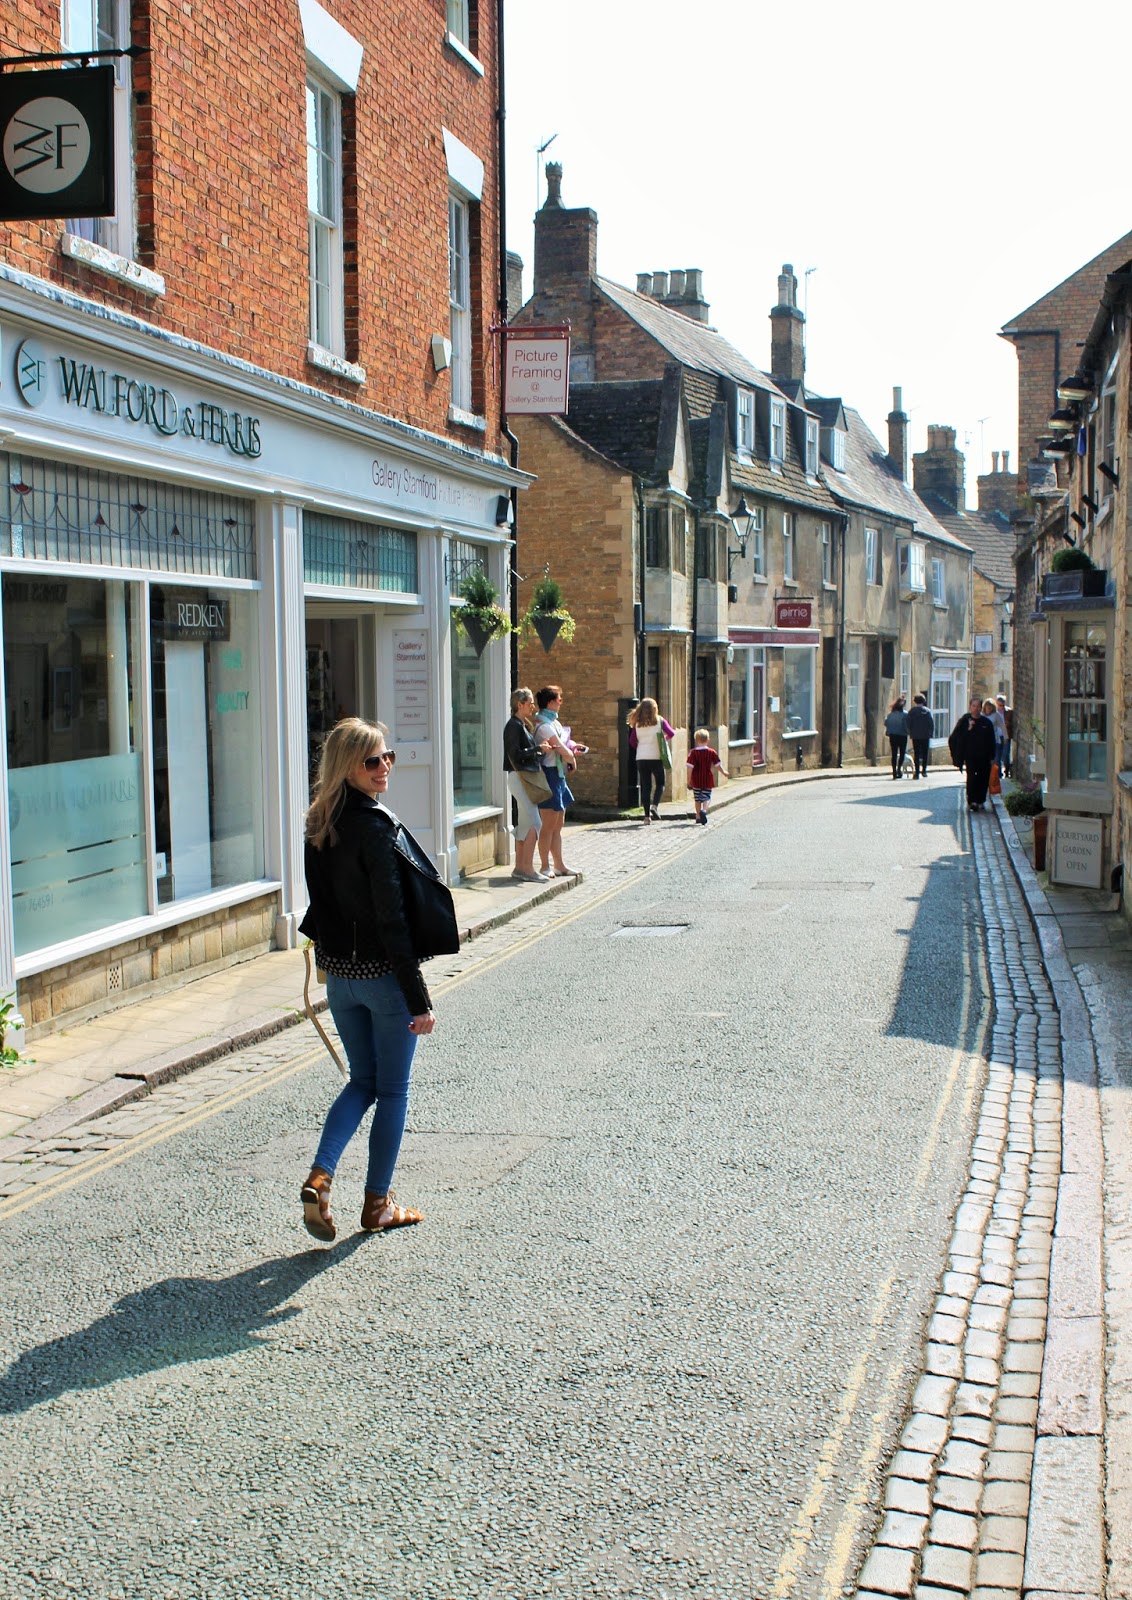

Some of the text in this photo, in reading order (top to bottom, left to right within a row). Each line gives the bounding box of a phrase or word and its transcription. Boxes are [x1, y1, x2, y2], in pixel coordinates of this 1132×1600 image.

[515, 350, 558, 361] Picture
[511, 366, 562, 381] Framing
[530, 382, 540, 392] @
[533, 395, 564, 403] Stamford
[59, 356, 262, 458] WALFORD & FERRIS
[371, 460, 401, 496] Gallery
[403, 468, 437, 500] Stamford
[177, 603, 225, 628] REDKEN
[398, 642, 422, 650] Gallery
[396, 653, 426, 661] Stamford
[410, 751, 416, 760] 3
[1056, 831, 1100, 843] COURTYARD
[1063, 845, 1092, 856] GARDEN
[1066, 861, 1088, 871] OPEN
